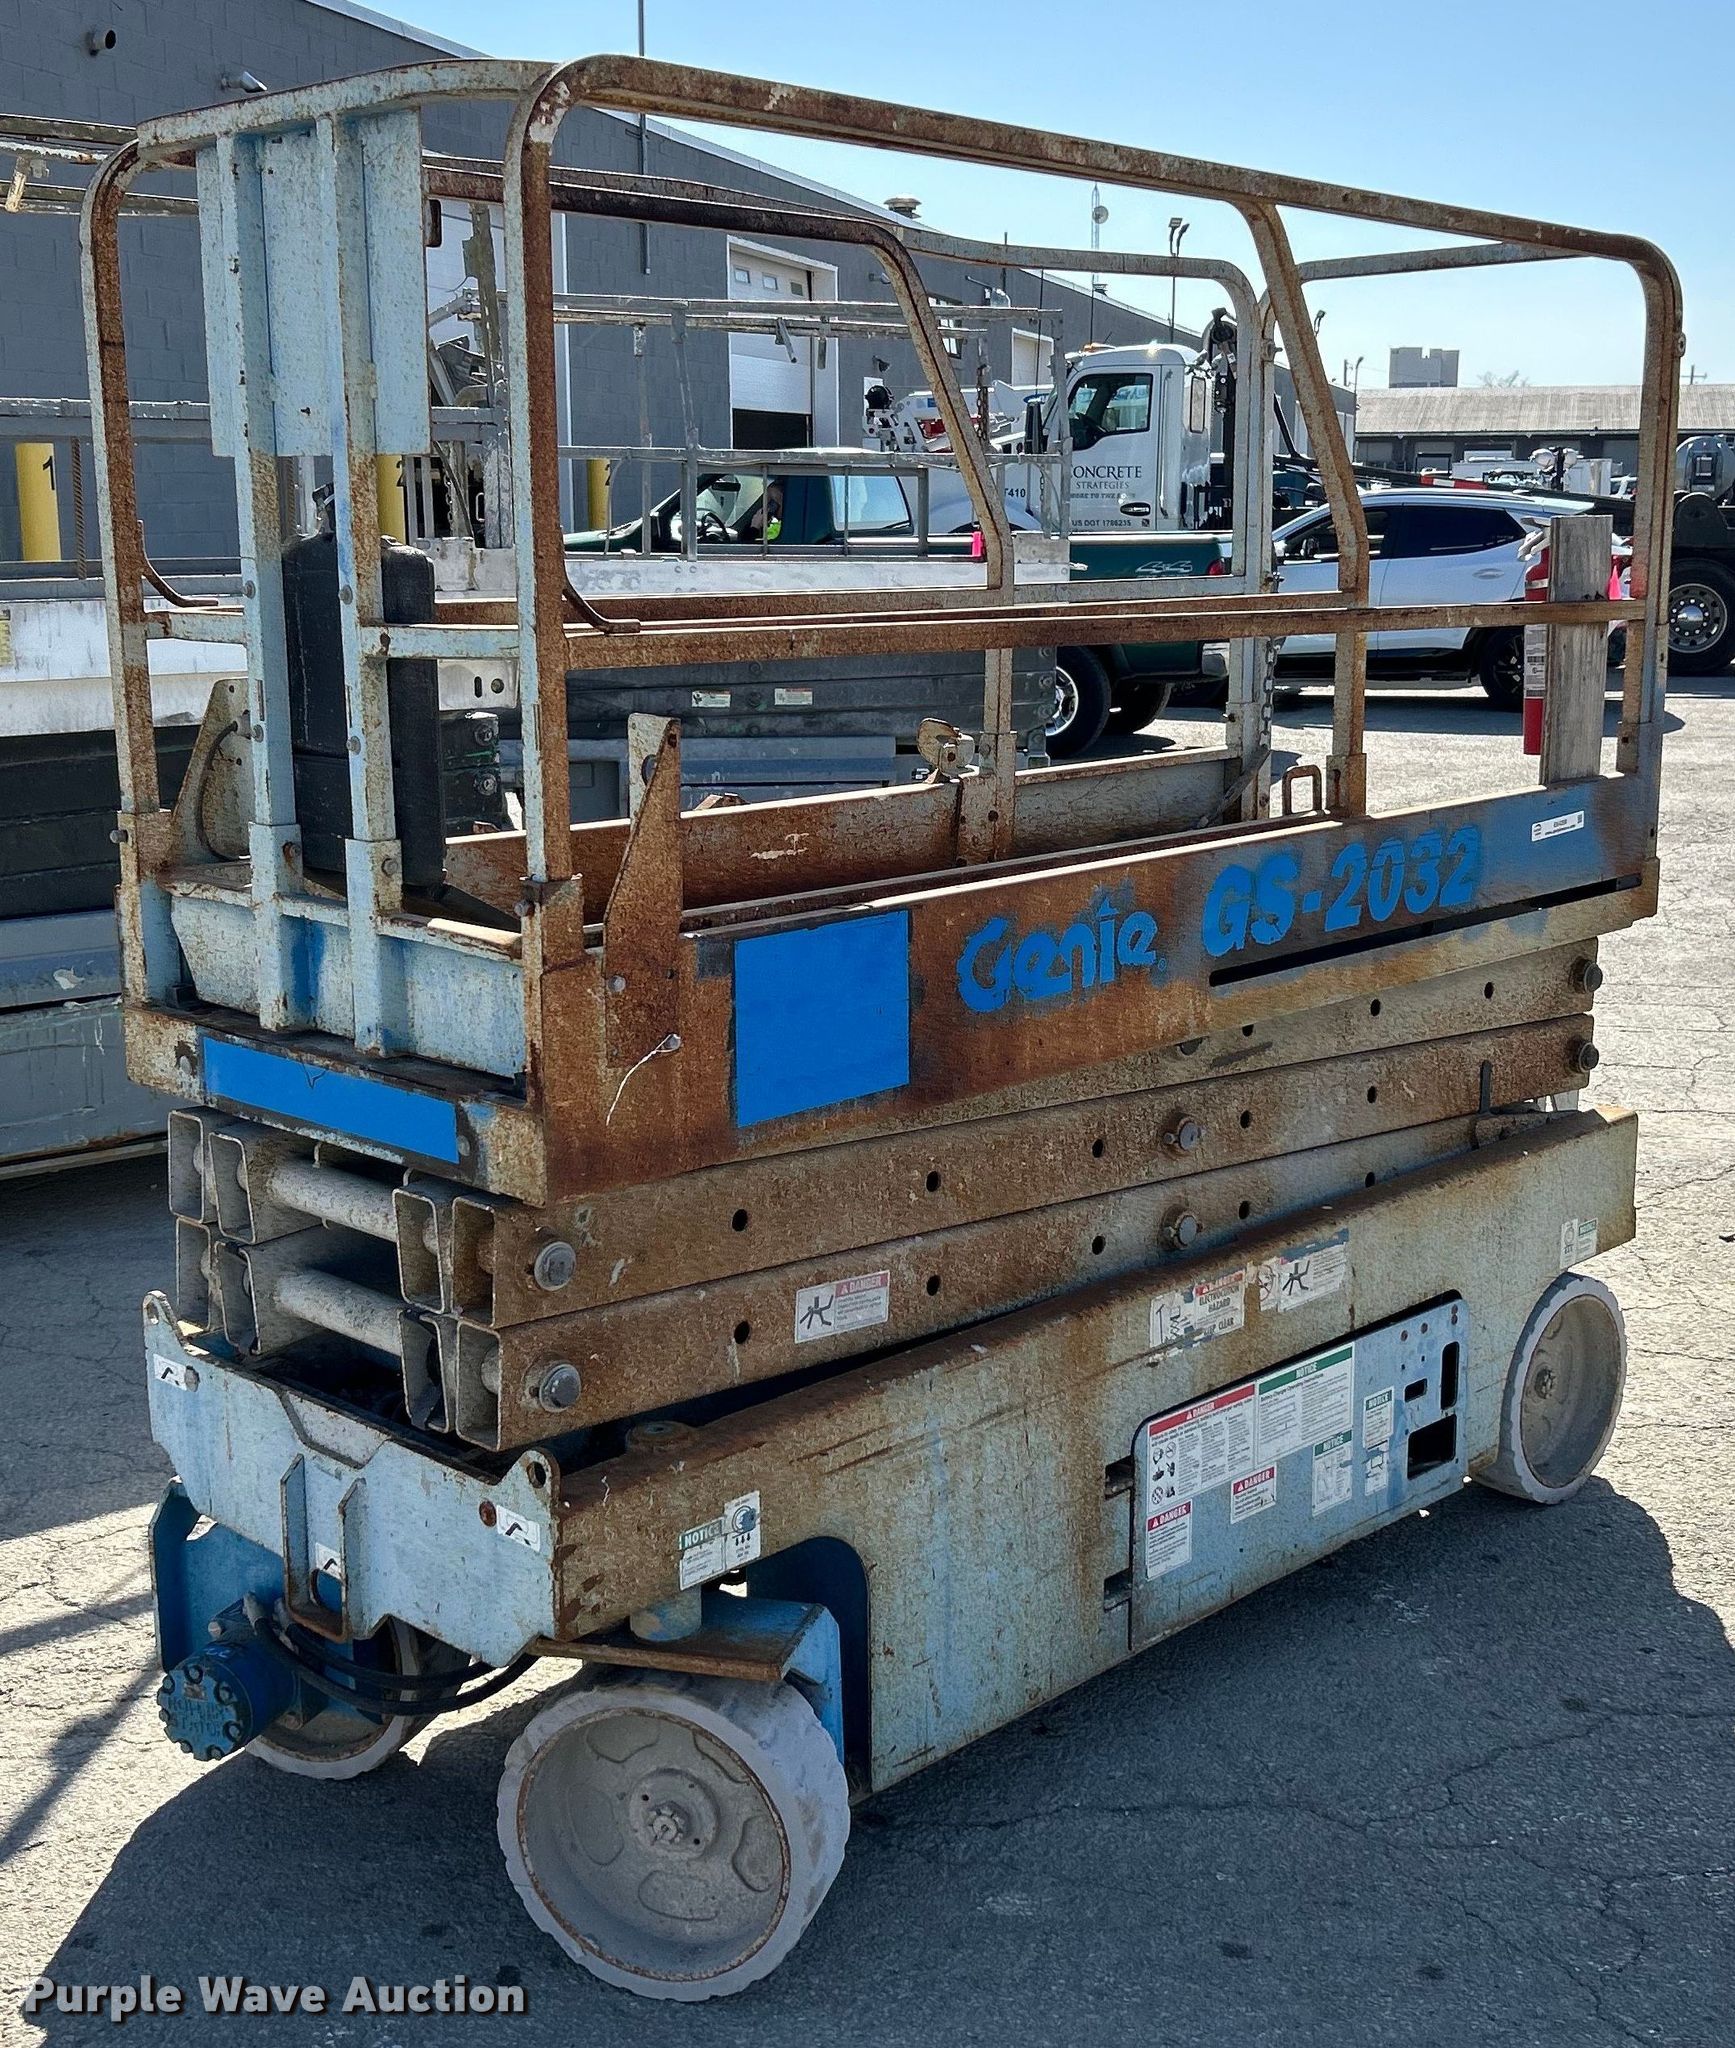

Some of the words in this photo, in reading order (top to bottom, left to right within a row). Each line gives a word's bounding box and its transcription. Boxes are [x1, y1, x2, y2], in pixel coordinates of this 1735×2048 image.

[43, 456, 54, 490] 1
[1071, 465, 1142, 480] ONCRETE
[1076, 481, 1129, 490] STRATEGIES
[1202, 824, 1481, 957] GS-2032
[956, 896, 1158, 1013] Genie
[849, 1275, 881, 1293] DANGER
[1208, 1297, 1231, 1312] HAZARD
[1218, 1317, 1235, 1331] CLEAR
[1296, 1362, 1318, 1379] NOTICE
[1192, 1401, 1215, 1418] DANGER
[1323, 1434, 1344, 1451] NOTICE
[1244, 1469, 1271, 1489] DANGER
[1160, 1505, 1187, 1522] DANGER
[684, 1522, 720, 1548] NOTICE
